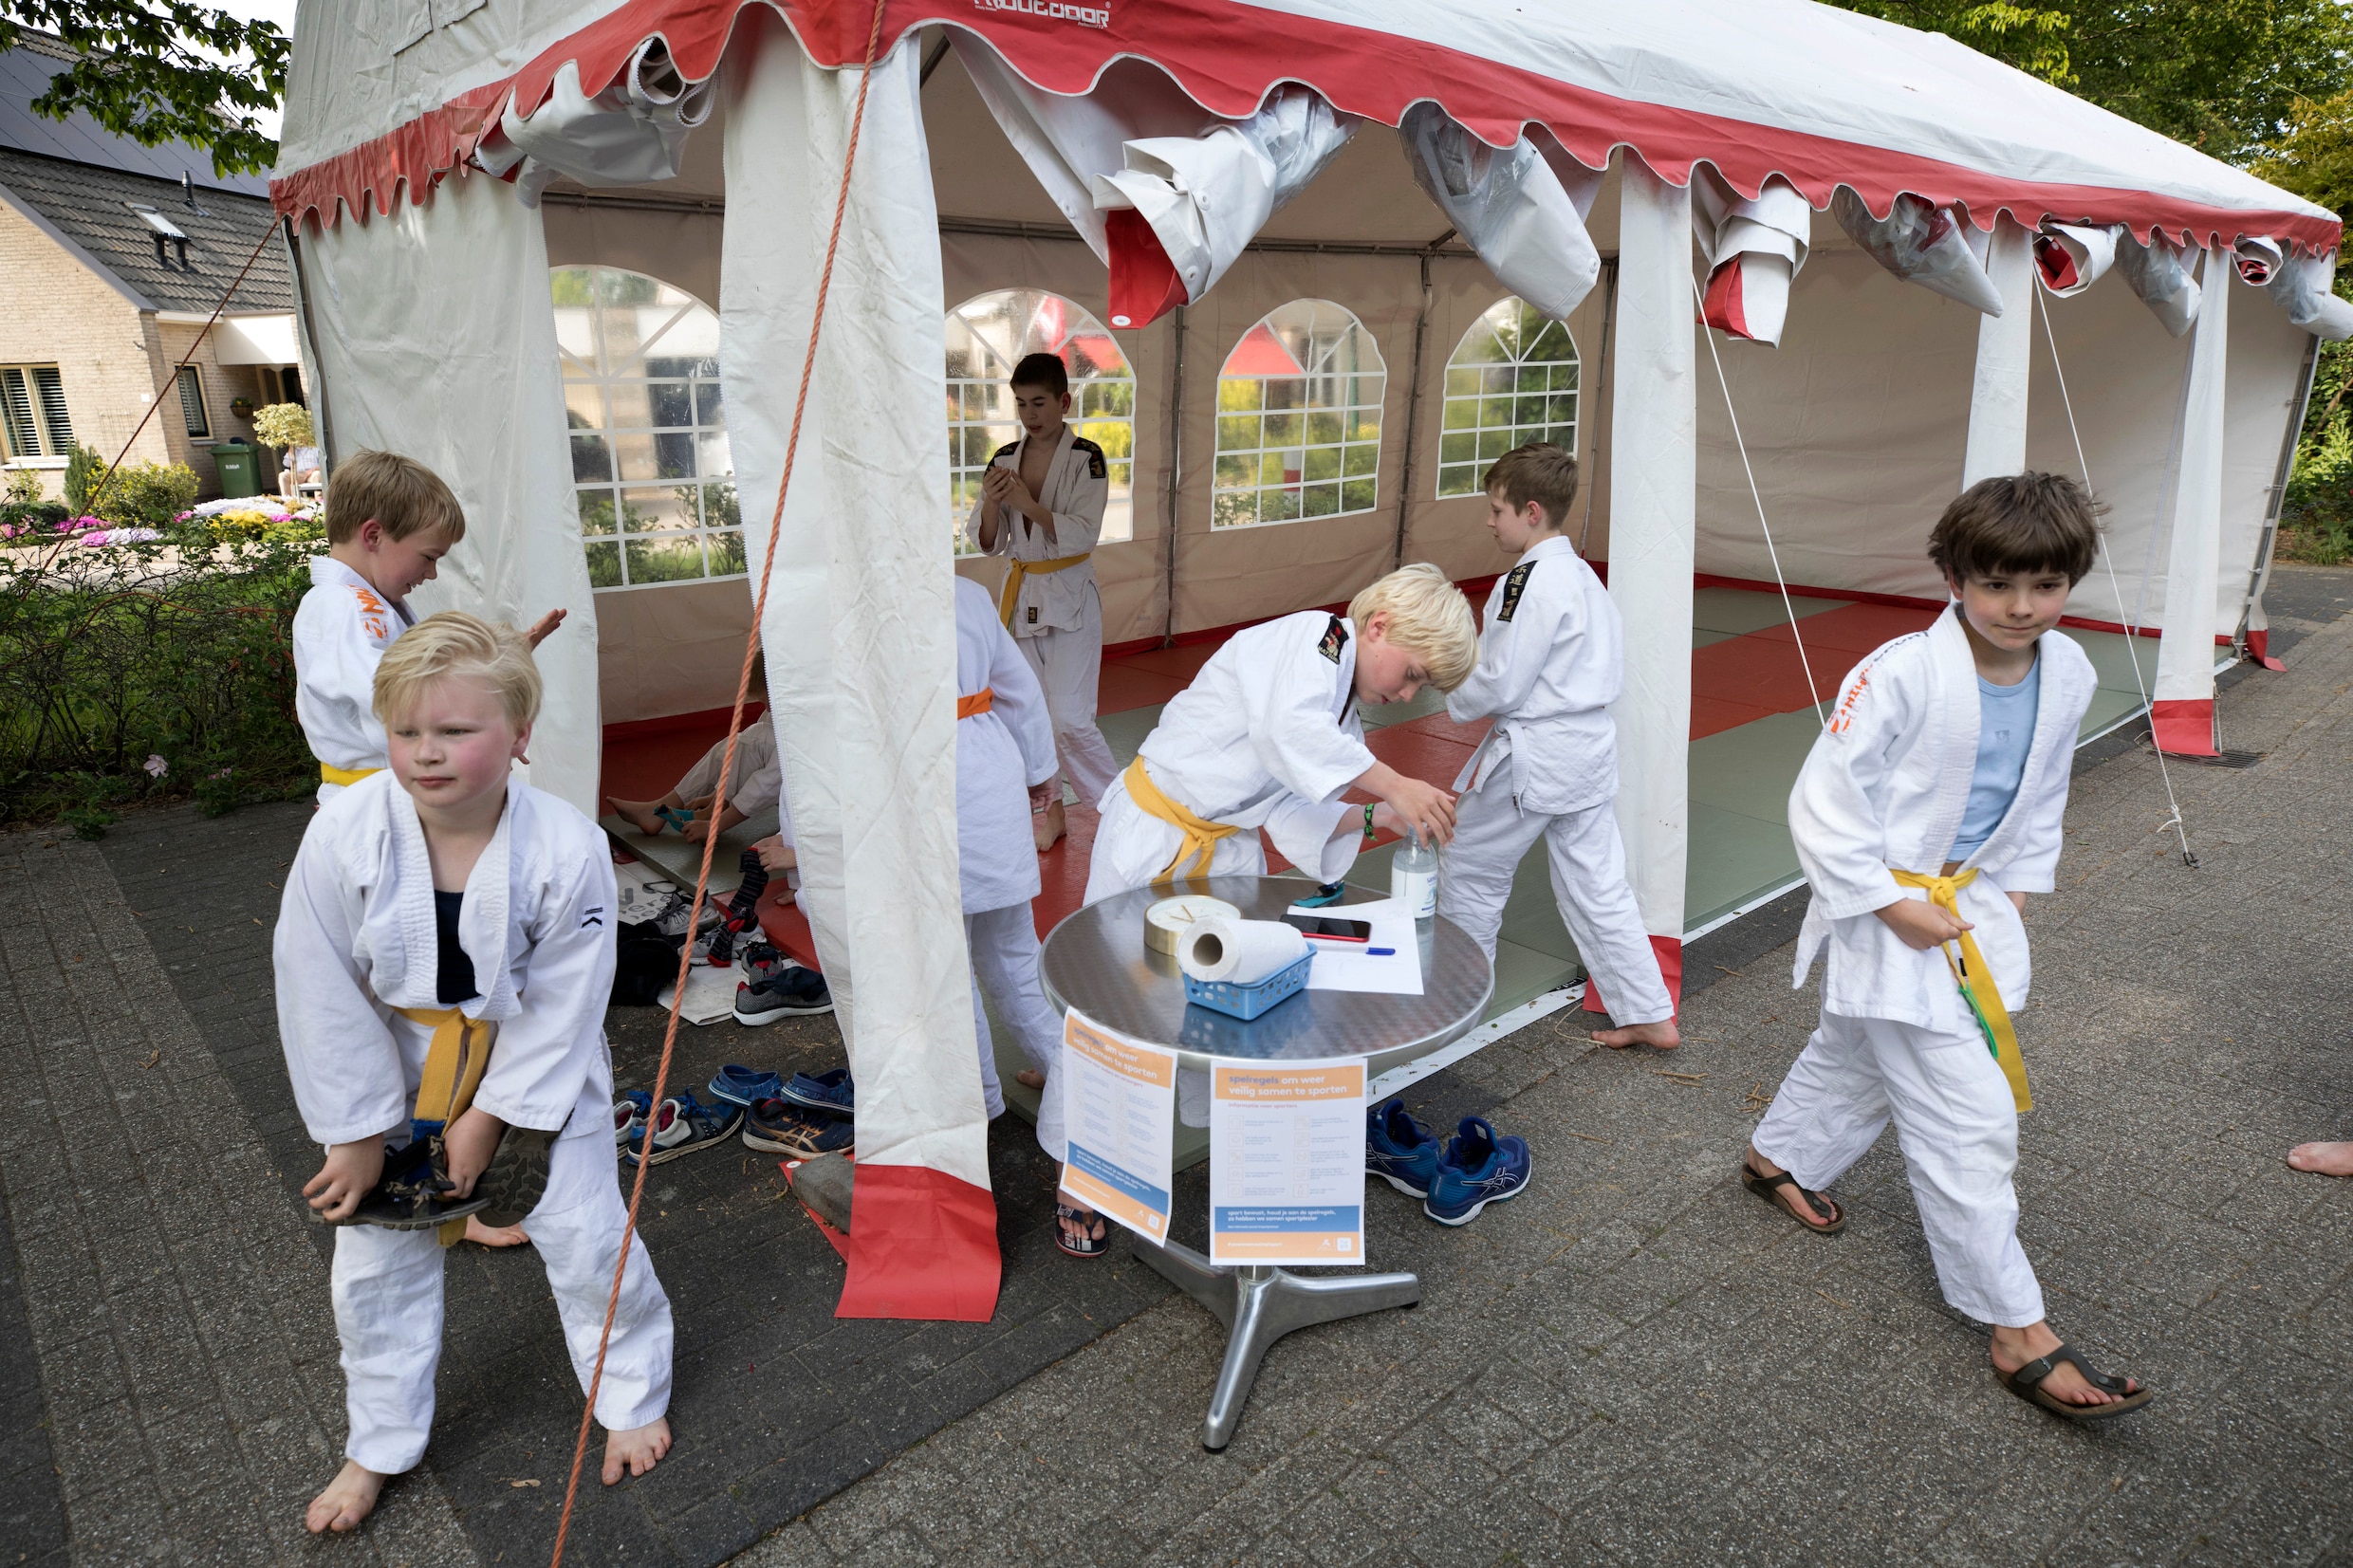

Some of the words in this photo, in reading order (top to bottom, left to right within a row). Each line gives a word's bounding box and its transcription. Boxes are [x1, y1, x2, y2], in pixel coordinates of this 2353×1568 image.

[1104, 1043, 1118, 1055] om
[1118, 1050, 1139, 1062] weer
[1091, 1047, 1113, 1062] samen
[1114, 1059, 1121, 1068] te
[1123, 1063, 1158, 1079] sporten
[1230, 1076, 1279, 1086] spelregels
[1300, 1076, 1325, 1084] weer
[1229, 1085, 1255, 1098] veilig
[1307, 1085, 1347, 1097] sporten
